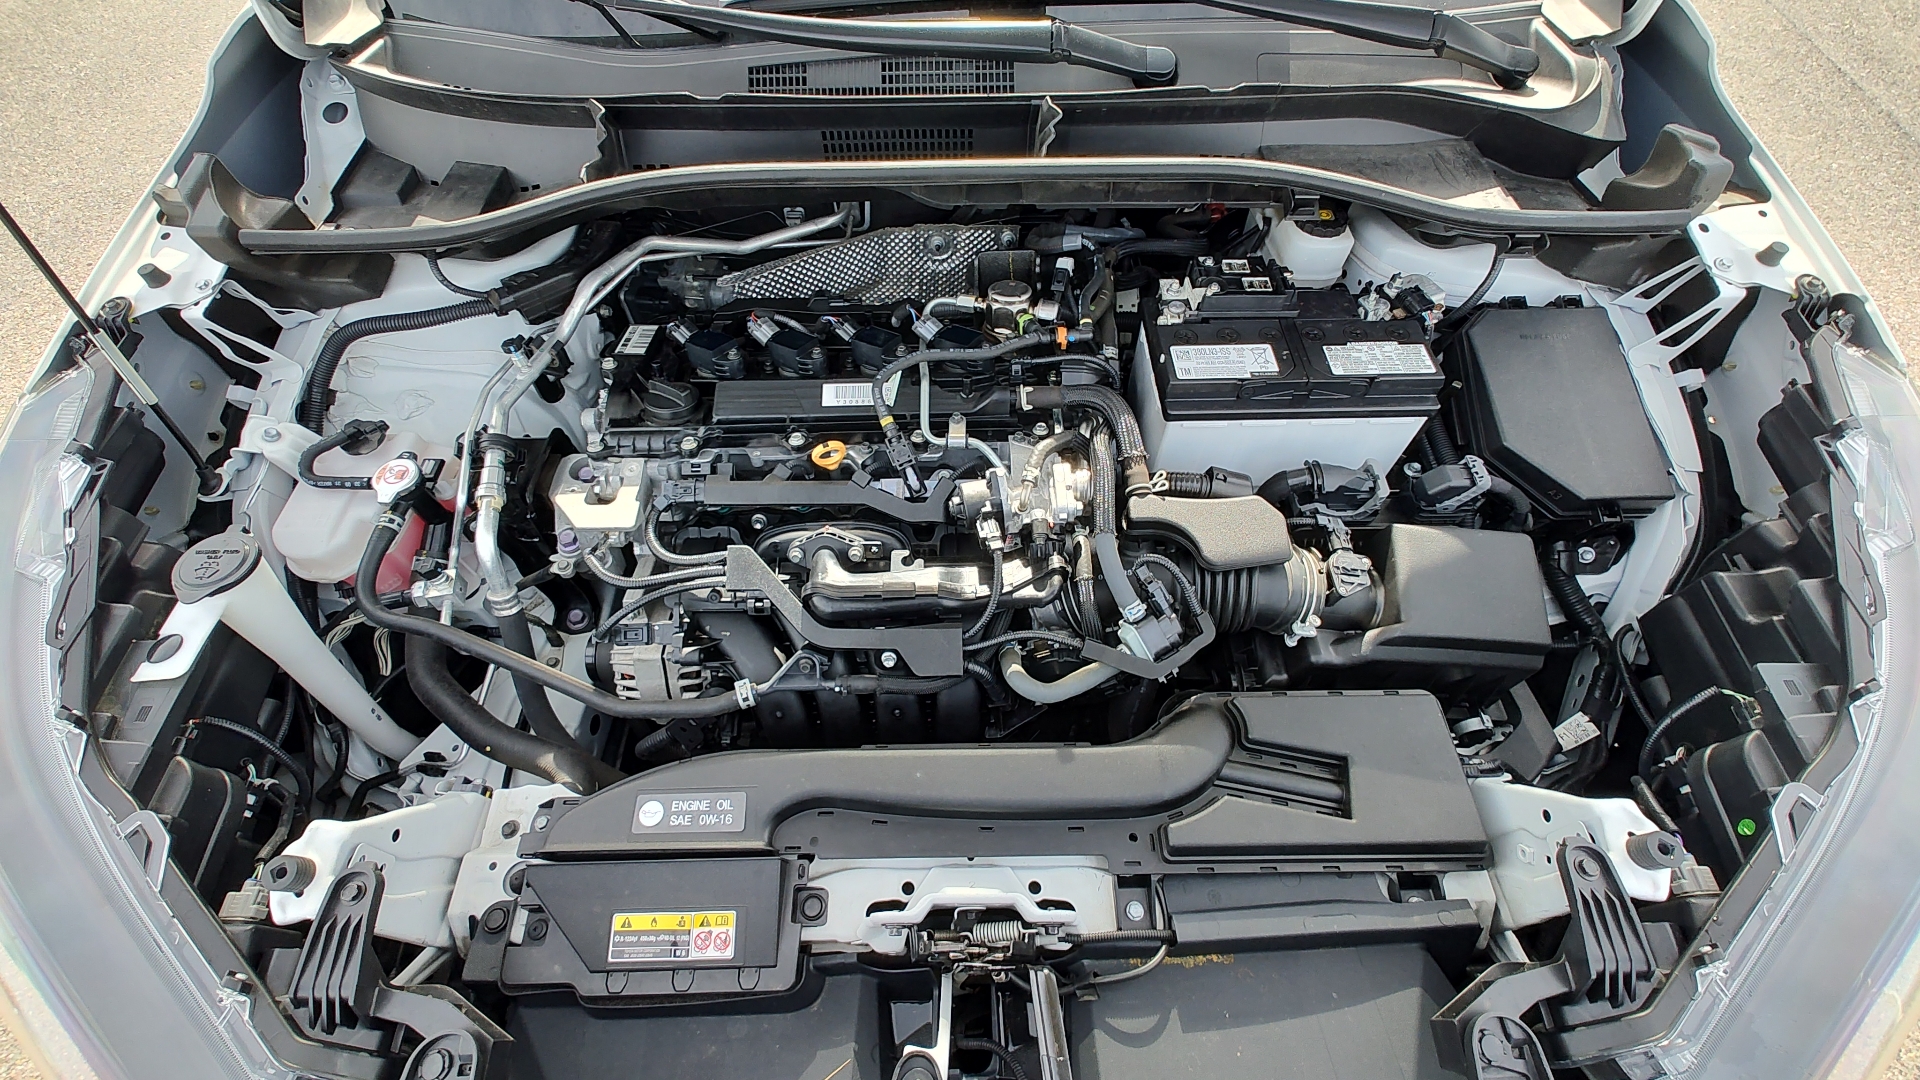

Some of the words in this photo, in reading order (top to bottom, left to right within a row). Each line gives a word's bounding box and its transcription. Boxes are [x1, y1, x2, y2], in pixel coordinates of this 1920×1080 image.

[1178, 366, 1192, 377] TM
[671, 800, 711, 811] ENGINE
[716, 799, 734, 810] OIL
[669, 814, 693, 826] SAE
[699, 814, 733, 825] 0W-16
